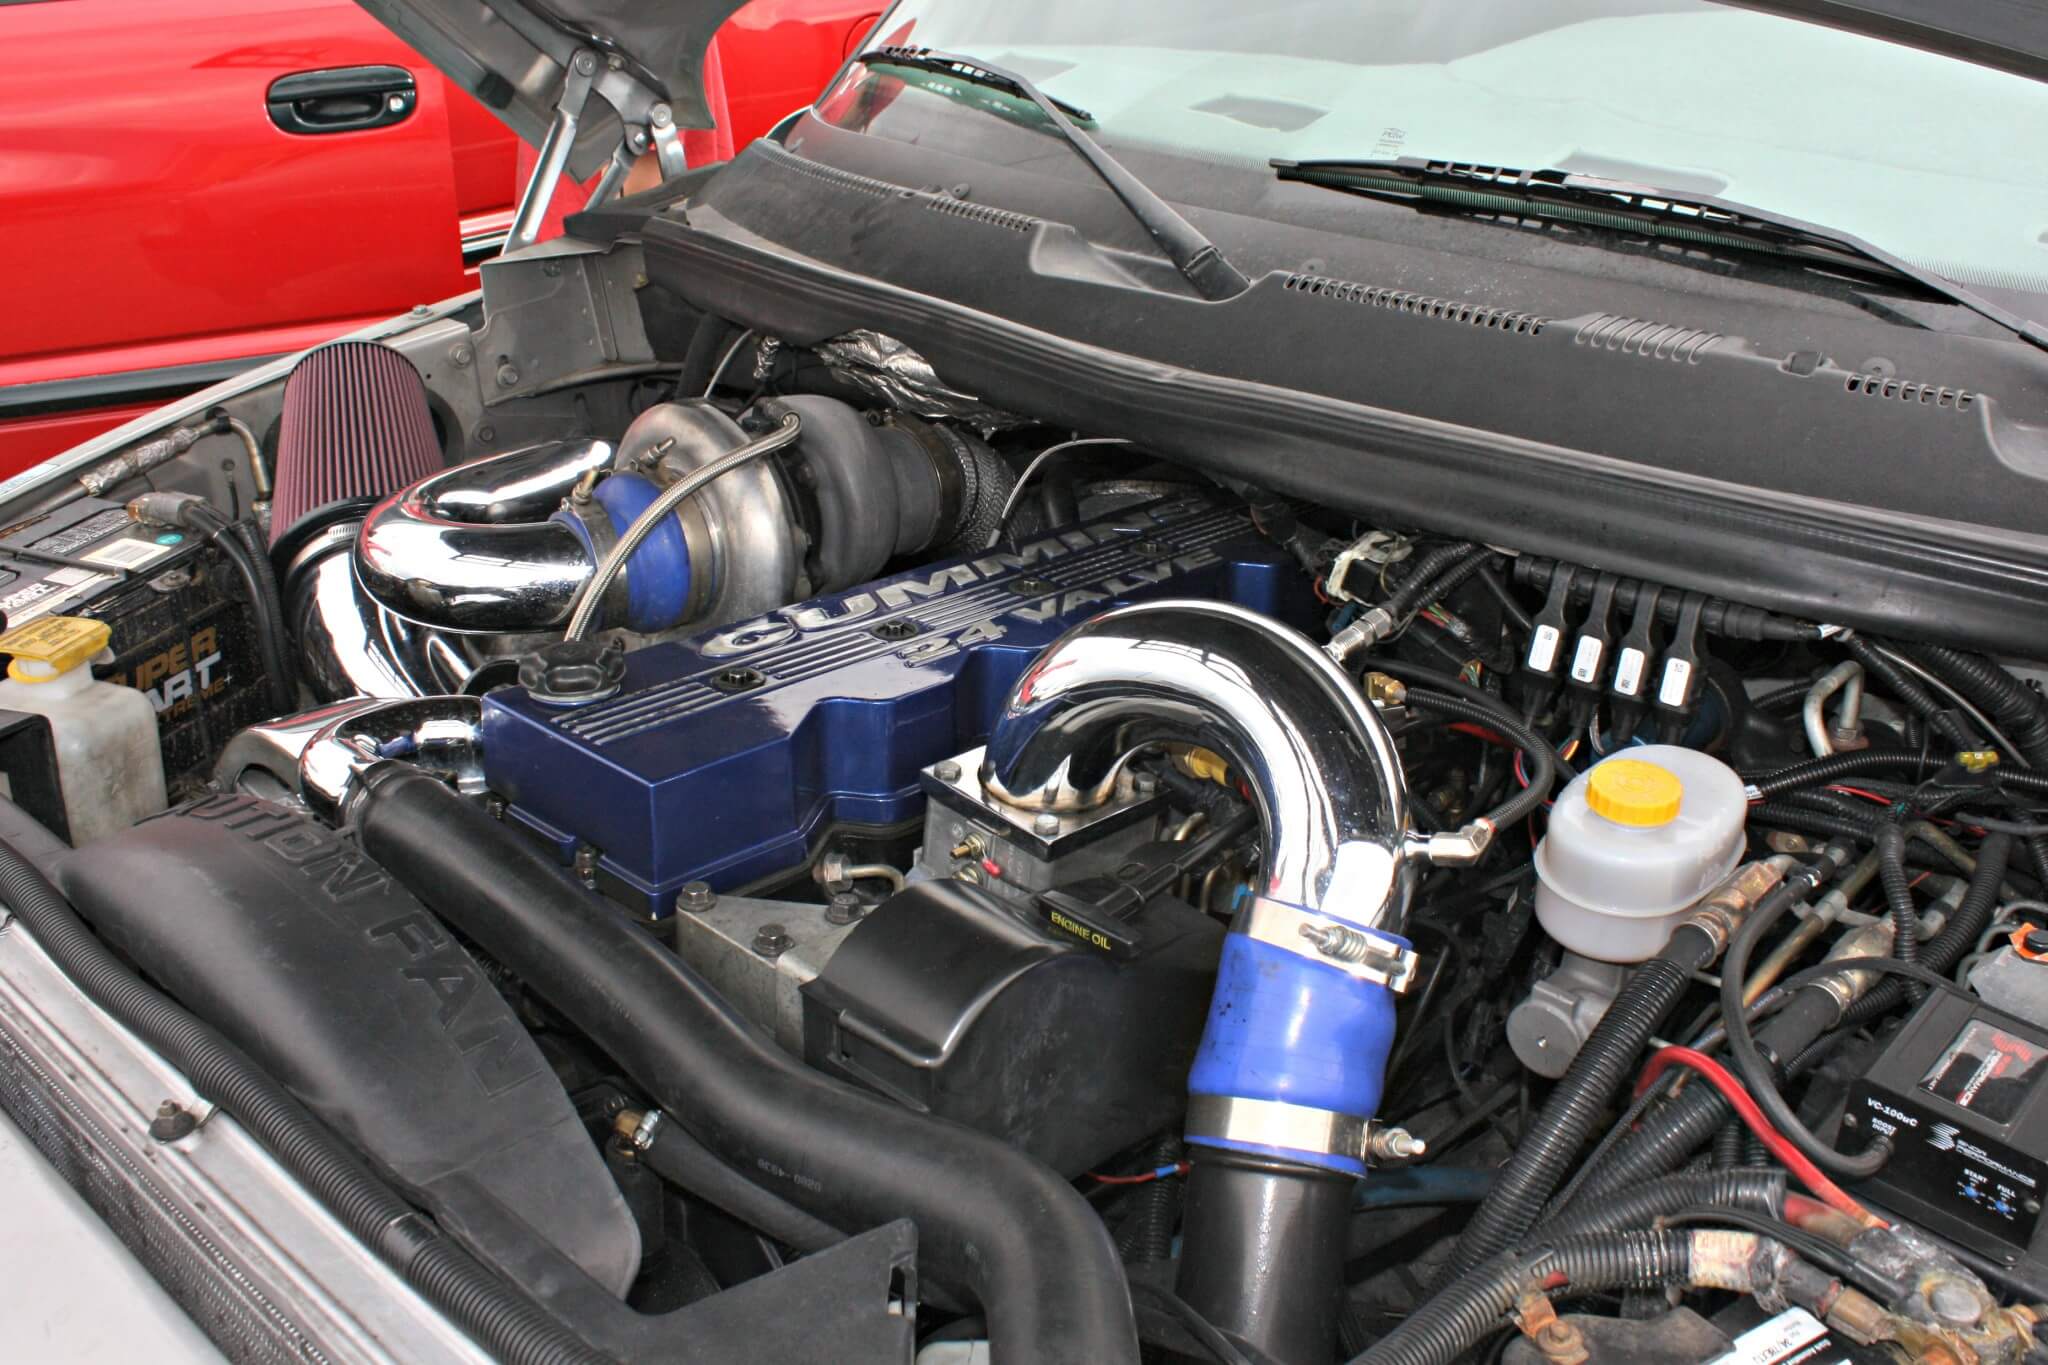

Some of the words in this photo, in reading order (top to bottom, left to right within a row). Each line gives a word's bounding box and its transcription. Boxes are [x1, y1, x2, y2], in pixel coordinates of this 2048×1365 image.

[700, 499, 1214, 658] CUMMINS
[898, 620, 1007, 668] 24
[1009, 547, 1224, 623] VALVE
[104, 626, 217, 690] UPER
[1051, 911, 1091, 940] ENGINE
[1091, 933, 1113, 951] OIL
[364, 908, 546, 1098] FAN
[1872, 1117, 1897, 1133] BOOST
[1963, 1168, 1988, 1184] START
[1997, 1184, 2016, 1198] FULL
